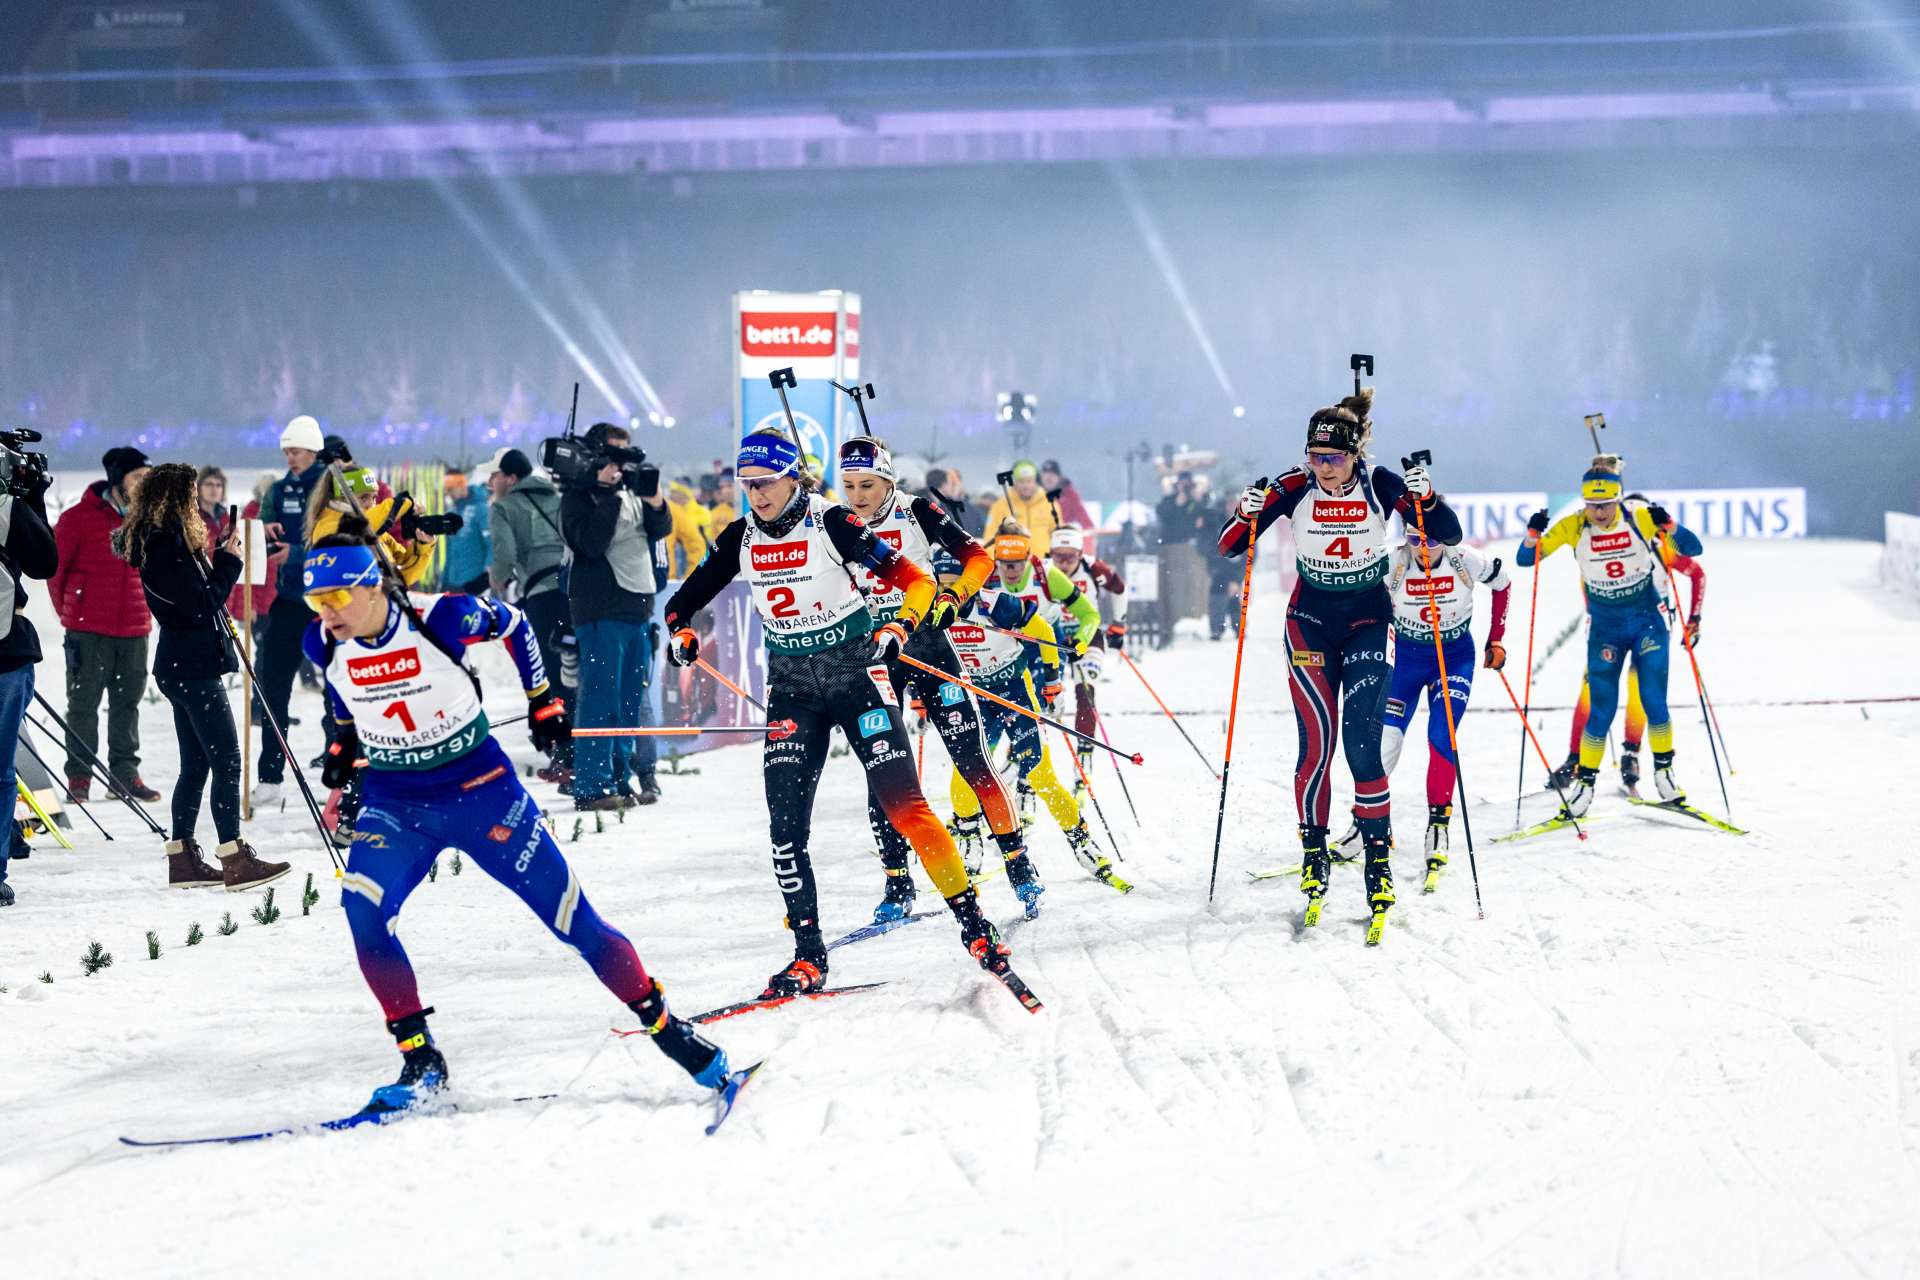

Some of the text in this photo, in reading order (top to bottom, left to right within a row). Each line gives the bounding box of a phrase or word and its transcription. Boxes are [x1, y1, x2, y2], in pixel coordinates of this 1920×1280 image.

[746, 325, 833, 345] bett1.de
[1316, 421, 1335, 432] ice
[903, 507, 916, 526] JOKA
[1315, 507, 1365, 517] bett1.de
[813, 511, 824, 533] JOKA
[742, 525, 755, 549] JOKA
[753, 549, 806, 564] bett1.de
[1324, 537, 1353, 559] 4
[760, 569, 797, 579] Deutschlands
[1605, 561, 1625, 578] 8
[786, 575, 813, 585] Matratze
[766, 587, 800, 619] 2
[812, 601, 823, 611] 1
[1420, 606, 1441, 624] 6
[949, 628, 983, 639] tt1.de
[959, 654, 981, 668] 5
[1343, 650, 1384, 666] ASKO
[350, 657, 417, 679] bett1.de
[383, 700, 416, 732] 1
[434, 710, 445, 719] 1
[864, 712, 885, 731] TQ
[865, 748, 907, 770] tectake
[515, 817, 544, 873] CRAFT
[772, 842, 803, 893] GER
